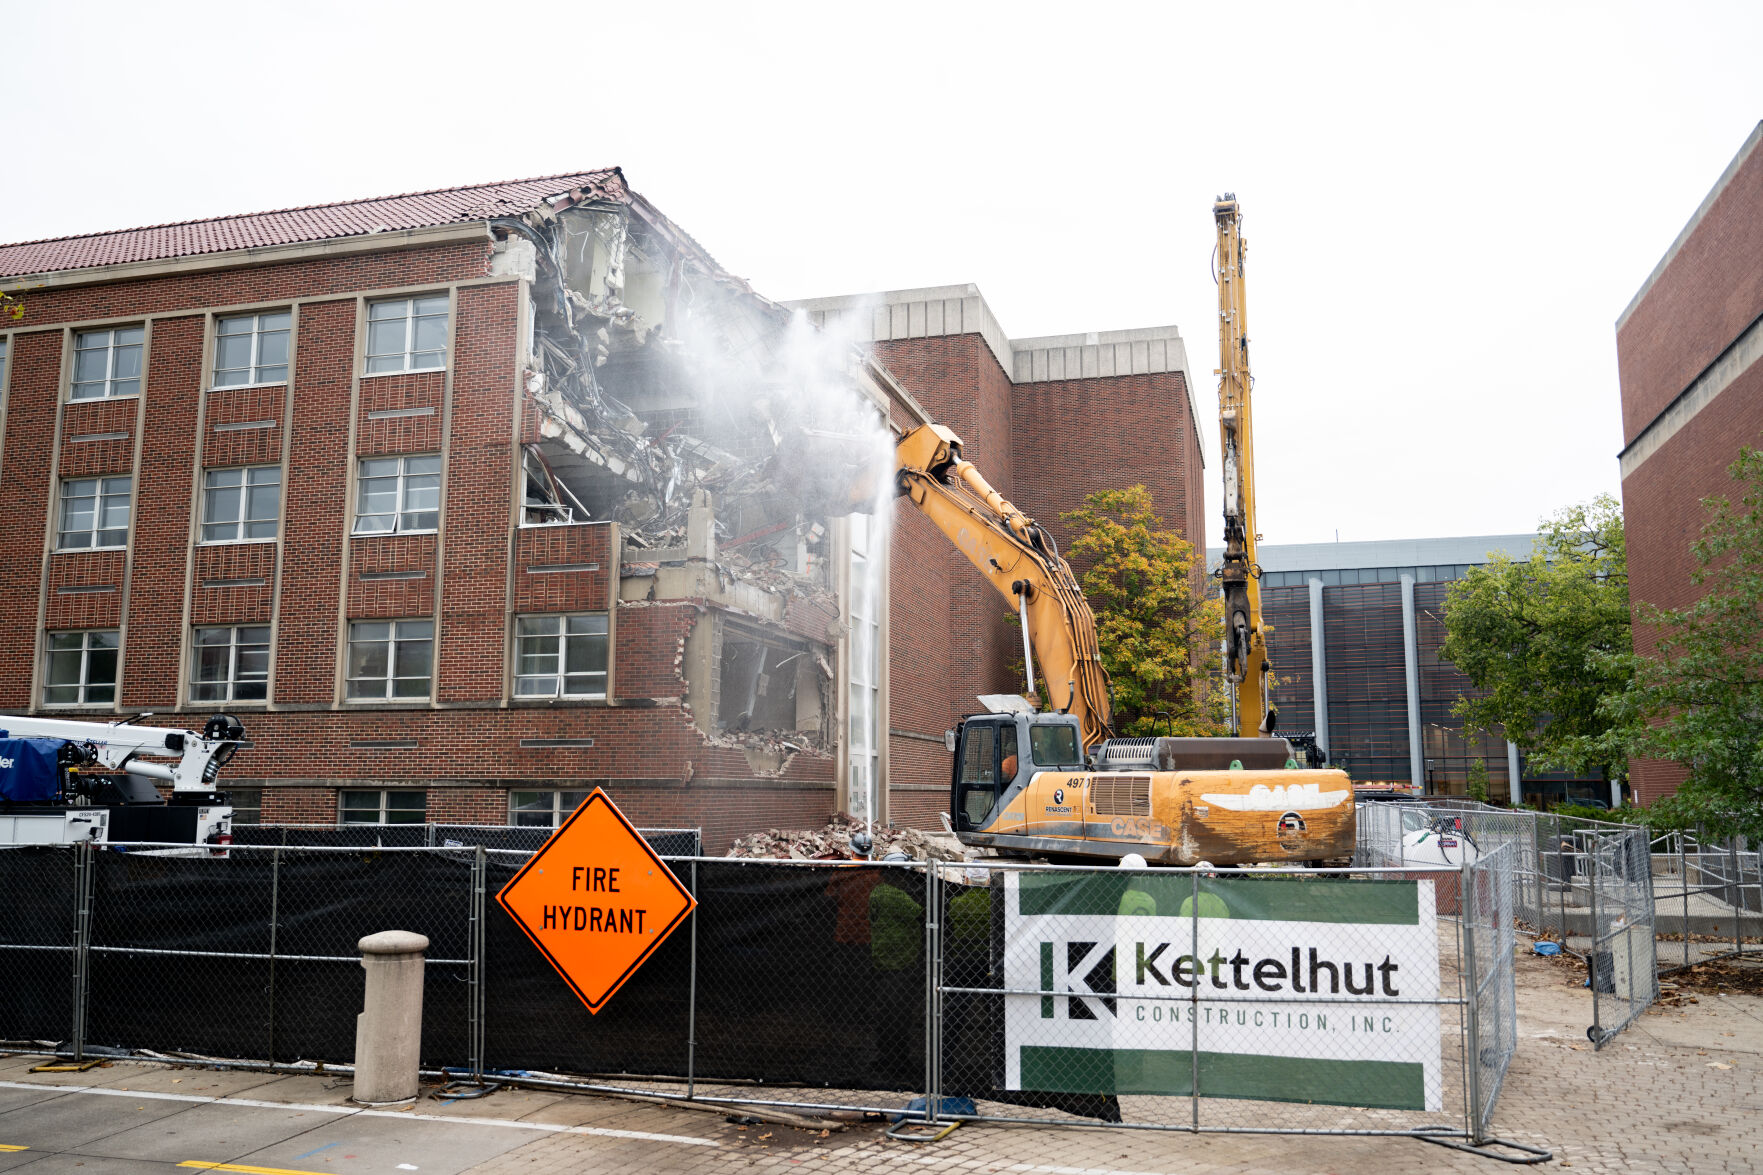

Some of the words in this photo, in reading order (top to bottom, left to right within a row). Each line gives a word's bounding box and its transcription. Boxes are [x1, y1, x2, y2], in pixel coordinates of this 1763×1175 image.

[1111, 817, 1162, 837] CASE
[572, 866, 620, 892] FIRE
[543, 905, 647, 934] HYDRANT
[1135, 941, 1399, 997] Kettelhut
[1136, 1005, 1336, 1033] CONSTRUCTION,
[1351, 1015, 1400, 1033] INC.
